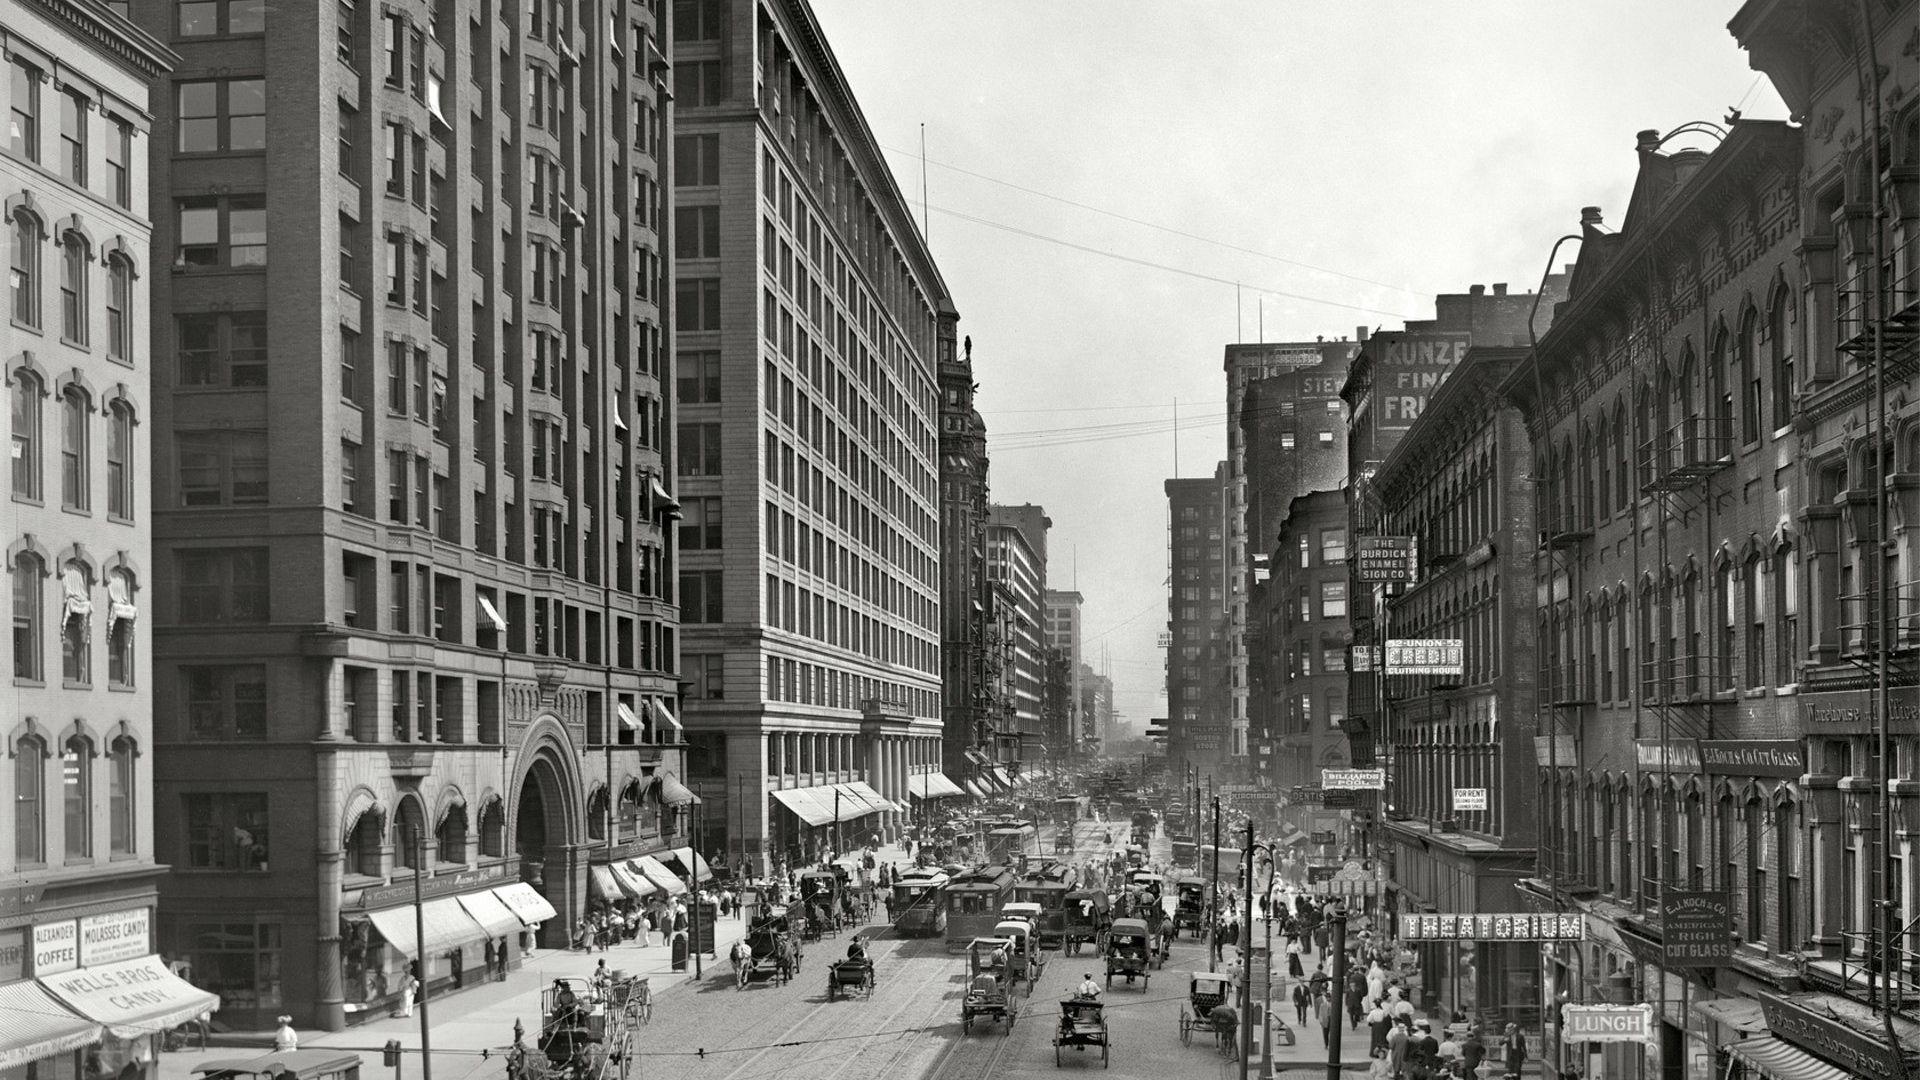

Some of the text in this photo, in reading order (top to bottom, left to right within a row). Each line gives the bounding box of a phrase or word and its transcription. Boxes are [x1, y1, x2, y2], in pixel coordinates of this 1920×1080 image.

[1374, 539, 1394, 548] THE
[1361, 550, 1407, 558] BURDICK
[1362, 560, 1405, 568] ENAMEL
[1363, 570, 1387, 579] SIGN
[1388, 666, 1461, 674] CLOTHING HOUSE
[1683, 898, 1706, 908] KOCH
[1404, 916, 1581, 938] THEATORIUM
[36, 925, 74, 944] ALEXANDER
[85, 924, 121, 945] MOLASSES
[1667, 944, 1686, 957] CUT
[36, 948, 74, 967] COFFEE
[59, 972, 119, 996] WELLS
